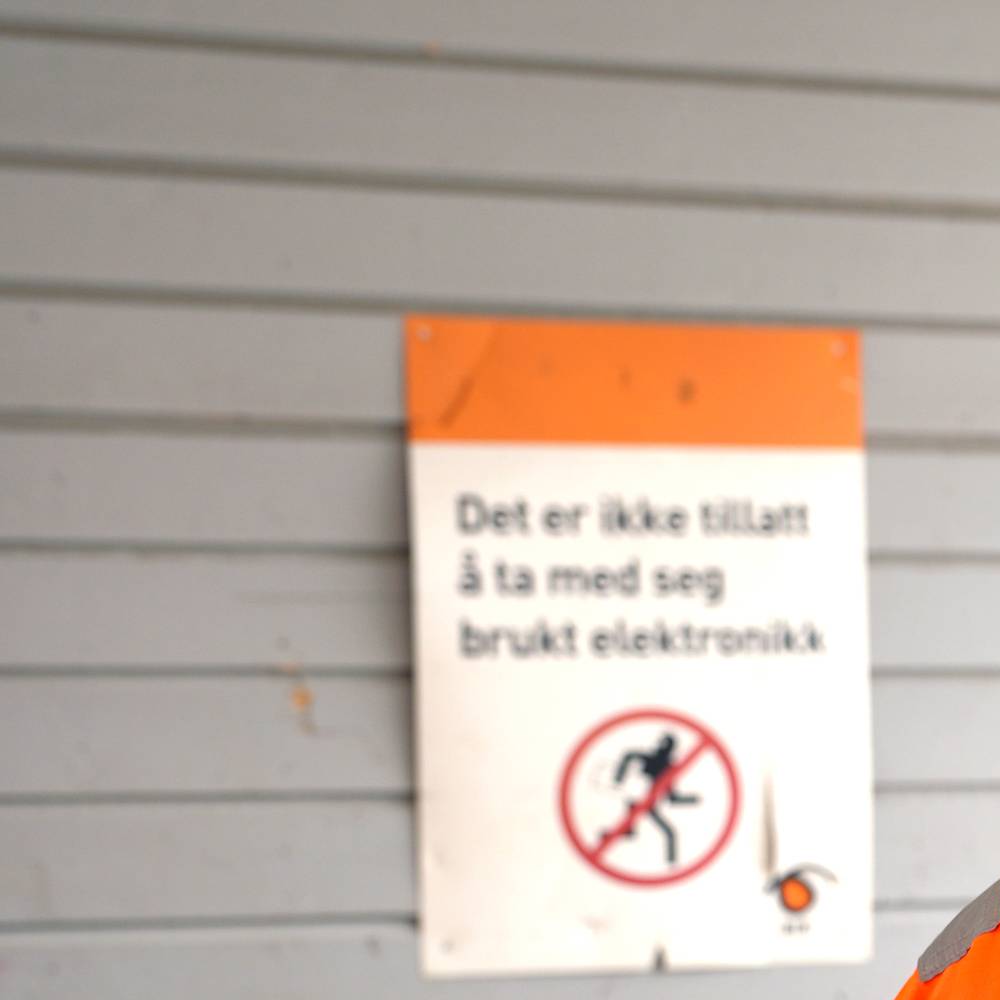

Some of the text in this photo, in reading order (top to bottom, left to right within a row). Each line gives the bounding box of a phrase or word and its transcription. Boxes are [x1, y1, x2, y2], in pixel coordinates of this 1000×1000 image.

[457, 494, 808, 534] Det er ikke tillatt
[459, 552, 724, 603] å ta med seg
[460, 620, 823, 657] brukt elektronikk
